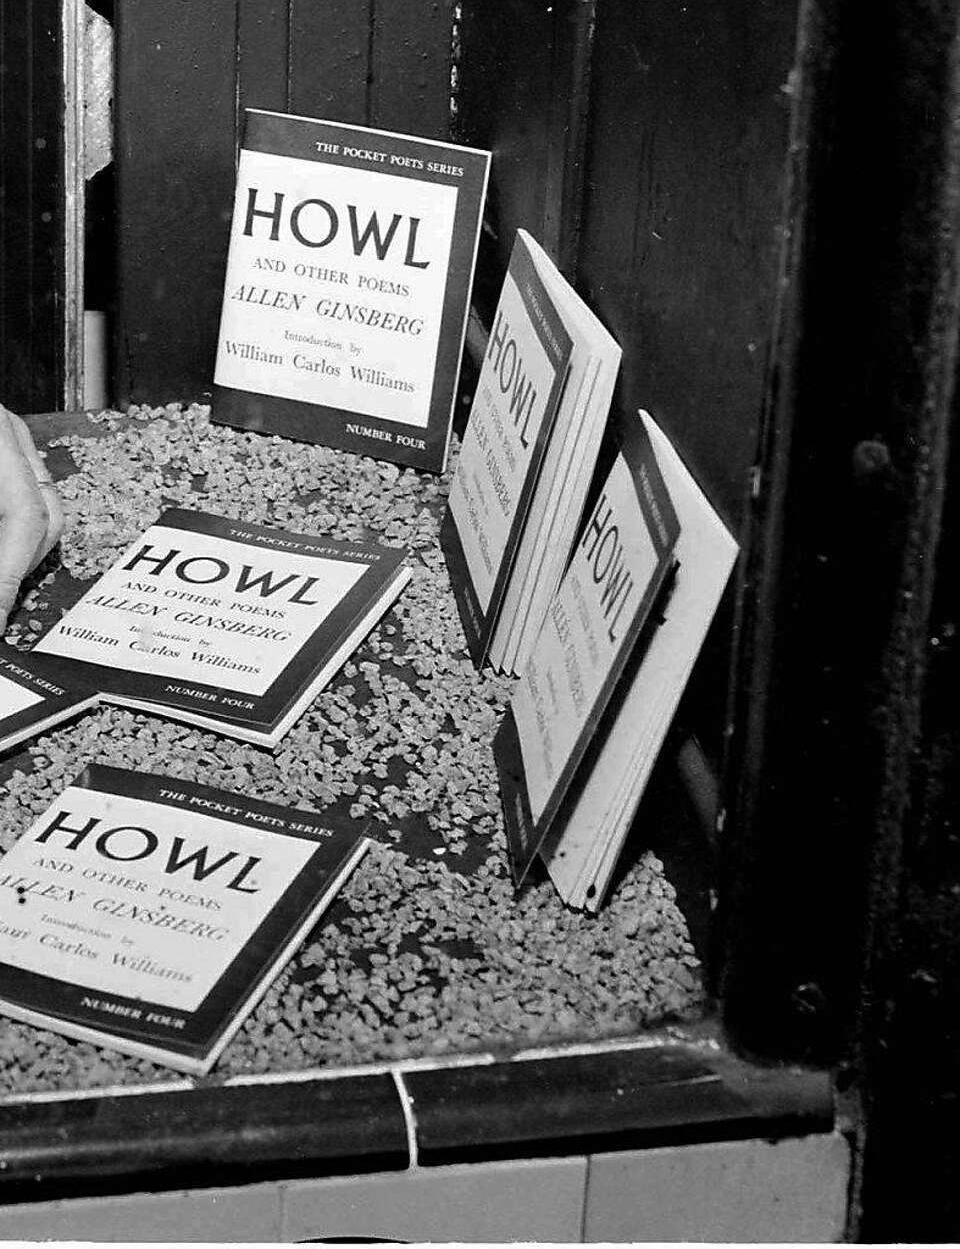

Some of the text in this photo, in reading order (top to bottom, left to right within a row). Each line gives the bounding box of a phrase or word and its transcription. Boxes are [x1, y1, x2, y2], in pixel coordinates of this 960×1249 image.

[316, 142, 464, 176] THE POCKET POETS SERIES
[243, 187, 429, 269] HOWL
[253, 258, 409, 296] AND OTHER POEMS
[232, 284, 424, 336] ALLEN GINSBERG
[284, 330, 343, 351] Introduction
[225, 341, 415, 393] William Carlos Williams
[489, 310, 536, 449] HOWL
[346, 424, 425, 449] NUMBER FOUR
[122, 544, 320, 606] HOWL
[582, 494, 633, 642] HOWL
[86, 595, 292, 642] ALLEN GINSBERG
[122, 582, 287, 619] AND OTHER POEMS
[59, 625, 119, 646] William
[191, 652, 262, 674] Williams
[166, 685, 255, 709] NUMBER FOUR
[159, 789, 335, 837] THE POCKET POETS SERIES
[35, 810, 262, 894] HOWL
[33, 858, 222, 911] AND OTHER POEMS
[93, 898, 230, 941] GINSBERG
[39, 933, 100, 960] Carlos
[113, 952, 194, 983] Williams
[81, 997, 186, 1029] NUMBER FOUR
